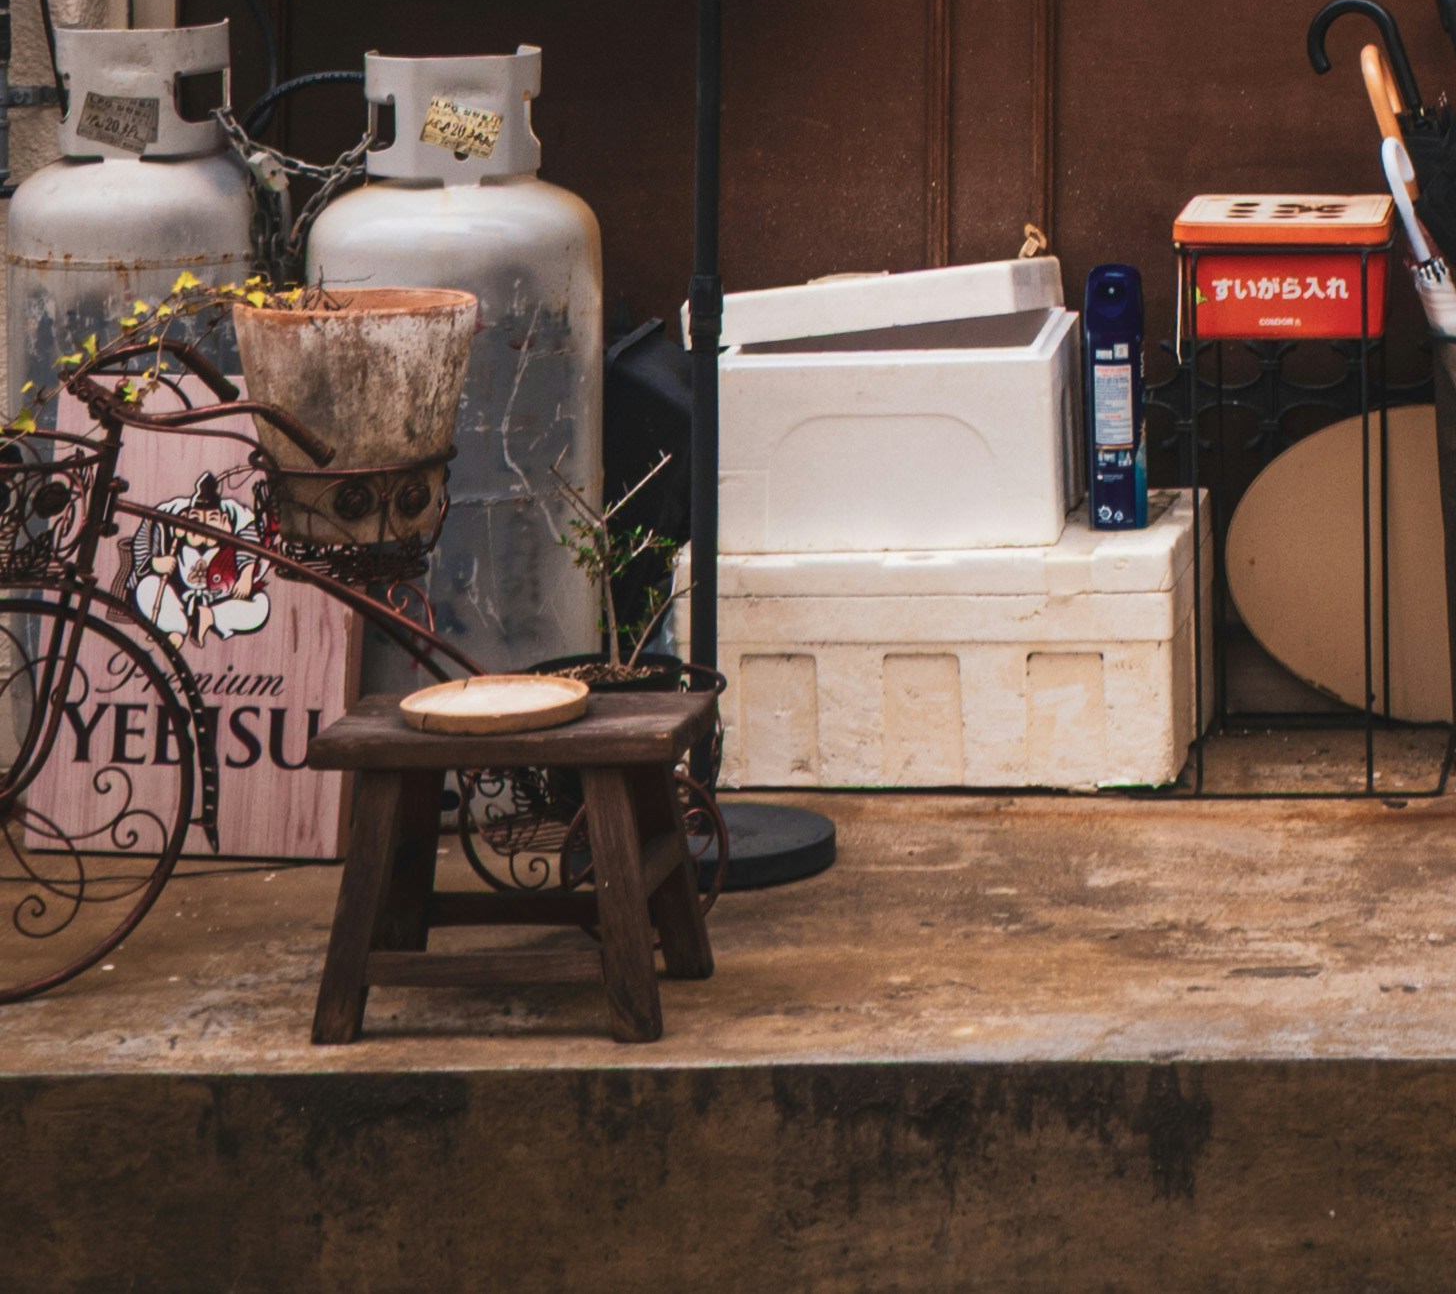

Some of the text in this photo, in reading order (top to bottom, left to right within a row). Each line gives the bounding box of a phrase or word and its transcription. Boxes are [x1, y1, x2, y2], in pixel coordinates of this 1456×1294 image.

[1211, 276, 1349, 301] すいがら入れ
